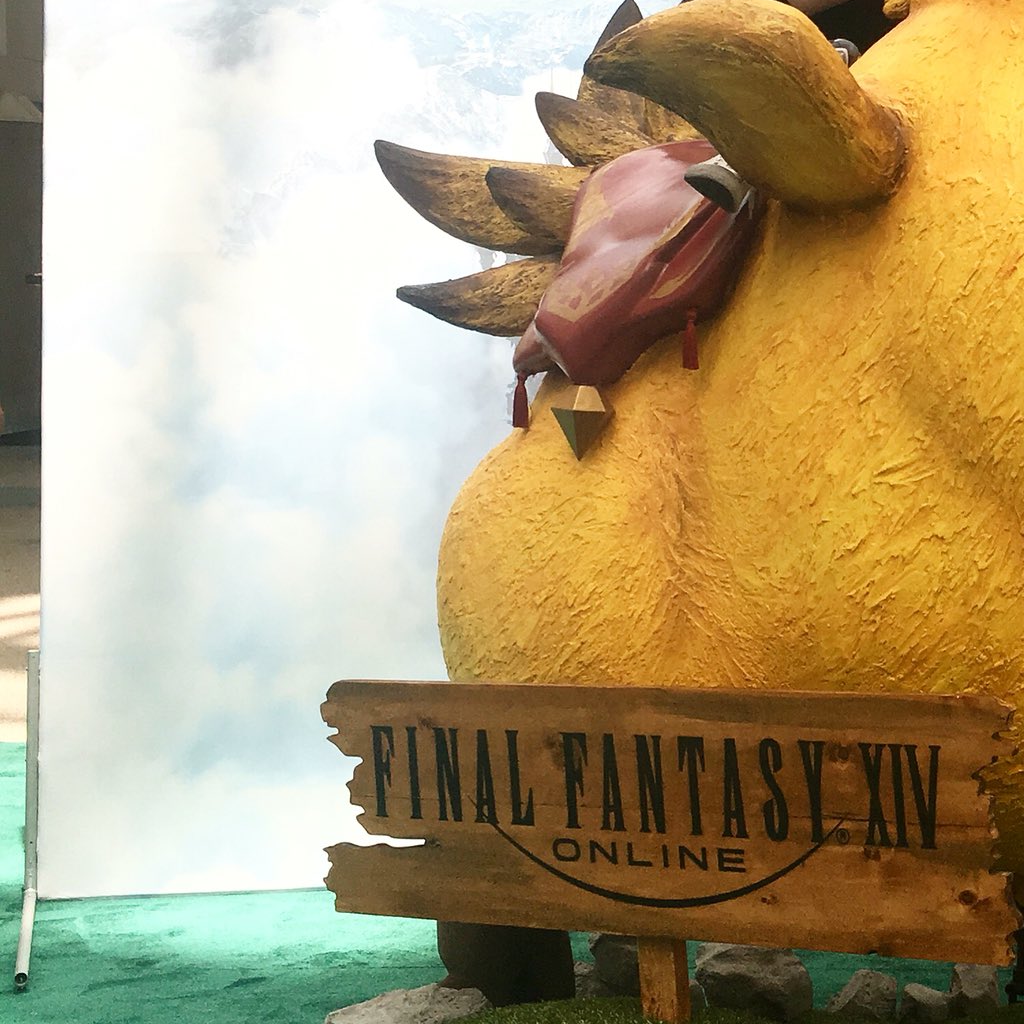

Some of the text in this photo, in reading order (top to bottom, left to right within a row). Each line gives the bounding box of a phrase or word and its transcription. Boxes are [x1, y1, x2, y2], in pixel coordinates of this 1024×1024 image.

[370, 725, 941, 849] FINAL FANTASY XIV
[552, 837, 747, 873] ONLINE
